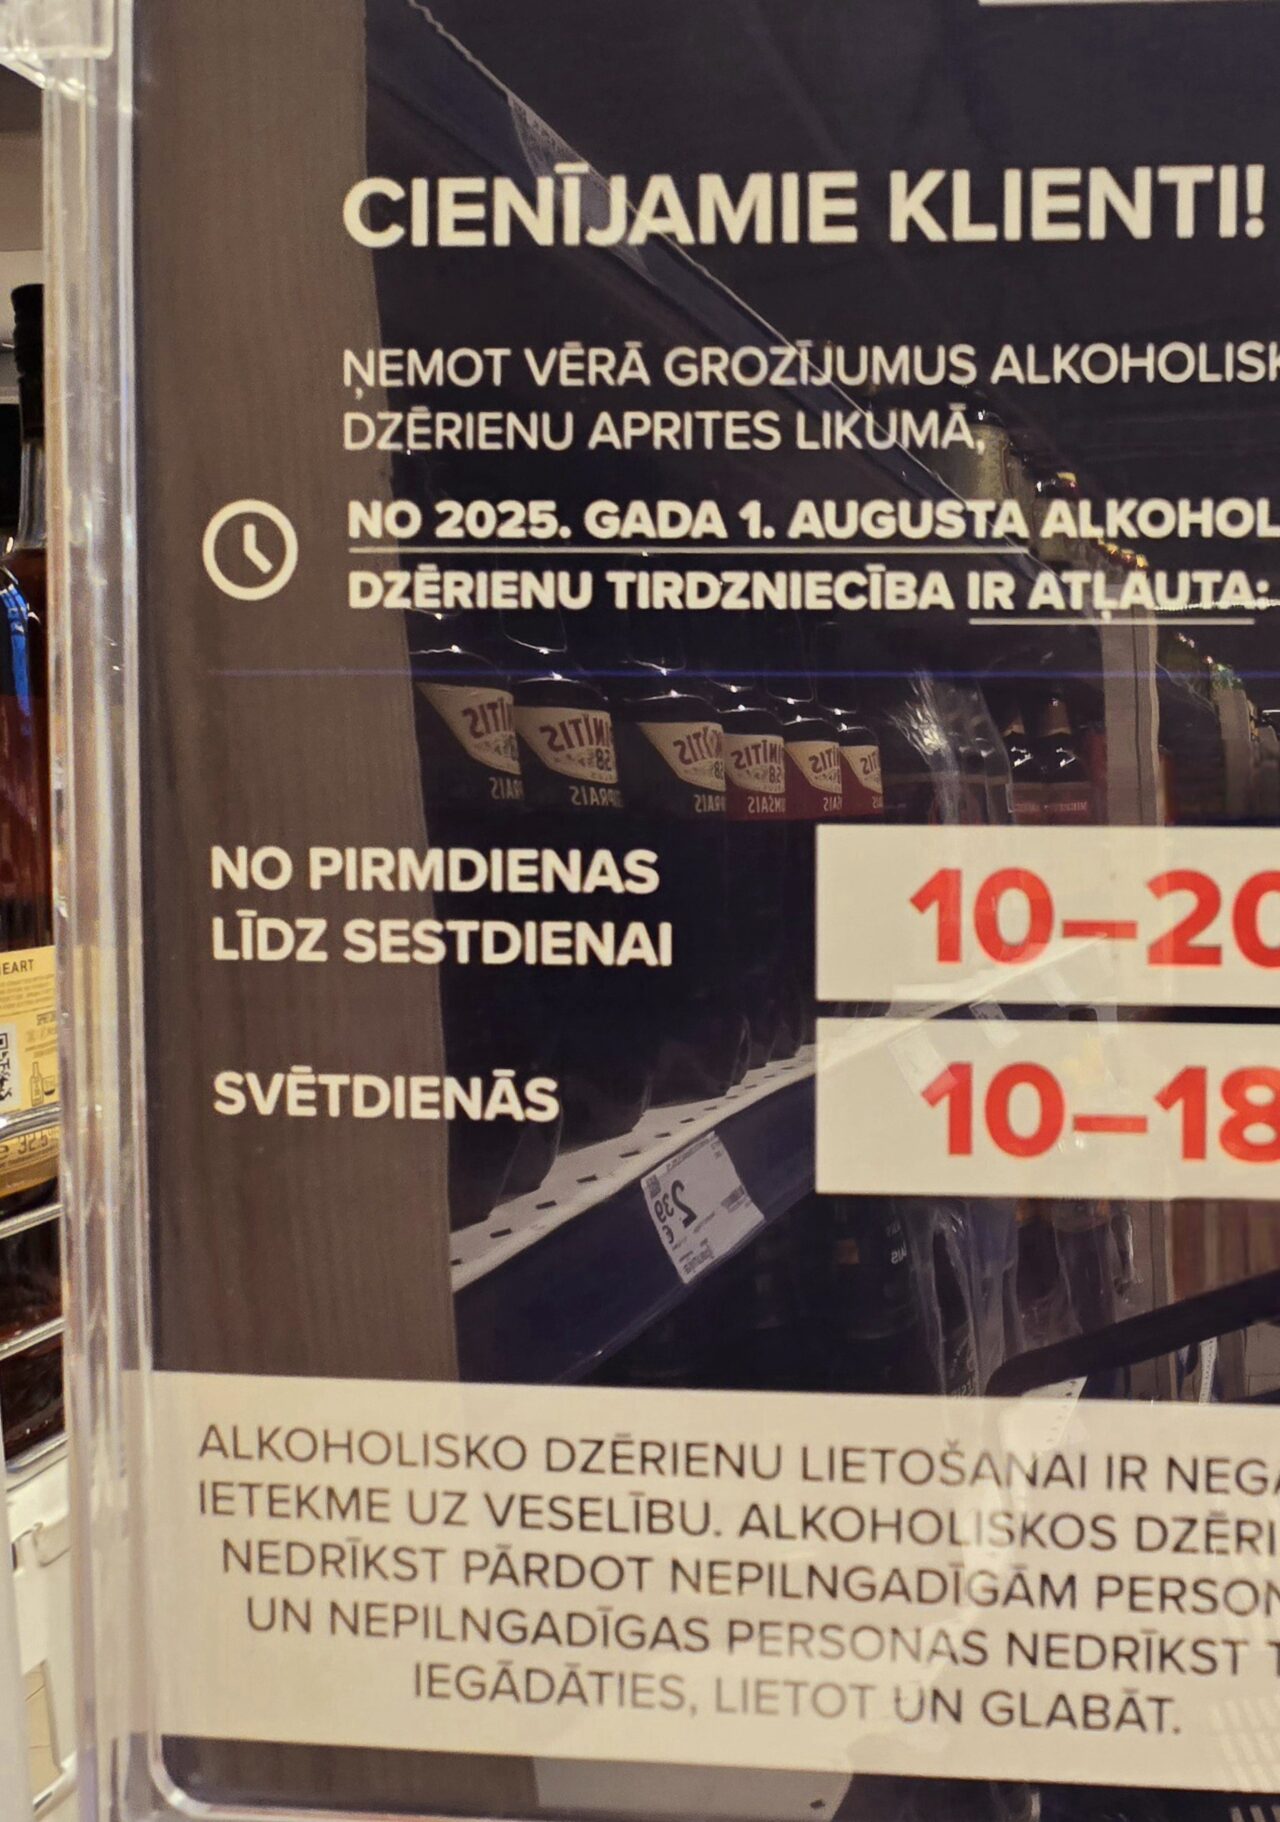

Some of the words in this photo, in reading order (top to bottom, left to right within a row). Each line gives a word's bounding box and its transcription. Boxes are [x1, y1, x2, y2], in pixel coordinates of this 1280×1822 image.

[342, 160, 858, 248] CIENĪJAMIE
[889, 164, 1266, 242] KLIENTI!
[342, 347, 512, 401] ŅEMOT
[524, 341, 651, 387] VĒRĀ
[663, 337, 977, 387] GROZĪJUMUS
[342, 405, 574, 451] DZĒRIENU
[588, 410, 782, 451] APRITES
[796, 403, 985, 456] LIKUMĀ,
[347, 499, 422, 539] NO
[434, 499, 572, 539] 2025.
[584, 499, 727, 539] GADA
[738, 499, 776, 539] 1.
[787, 498, 1030, 539] AUGUSTA
[348, 563, 593, 611] DZĒRIENU
[605, 563, 954, 611] TIRDZNIECĪBA
[967, 570, 1015, 610] IR
[1027, 570, 1270, 619] ATĻAUTA:
[211, 845, 293, 891] NO
[308, 846, 660, 894] PIRMDIENAS
[212, 909, 328, 962] LĪDZ
[342, 917, 672, 967] SESTDIENAI
[213, 1064, 560, 1123] SVĒTDIENĀS
[198, 1423, 527, 1472] ALKOHOLISKO
[545, 1433, 783, 1480] DZĒRIENU
[801, 1439, 1087, 1490] LIETOŠANAI
[1106, 1454, 1147, 1490] IR
[199, 1480, 391, 1523] IETEKME
[407, 1490, 468, 1527] UZ
[483, 1490, 723, 1537] VESELĪBU.
[738, 1502, 1117, 1552] ALKOHOLISKOS
[222, 1536, 448, 1583] NEDRĪKST
[464, 1544, 655, 1592] PĀRDOT
[671, 1558, 1077, 1610] NEPILNGADĪGĀM
[247, 1596, 312, 1634] UN
[329, 1601, 710, 1653] NEPILNGADĪGAS
[727, 1619, 988, 1667] PERSONAS
[1007, 1629, 1249, 1677] NEDRĪKST
[414, 1660, 698, 1717] IEGĀDĀTIES,
[715, 1677, 878, 1720] LIETOT
[894, 1686, 963, 1725] UN
[981, 1686, 1182, 1734] GLABĀT.
